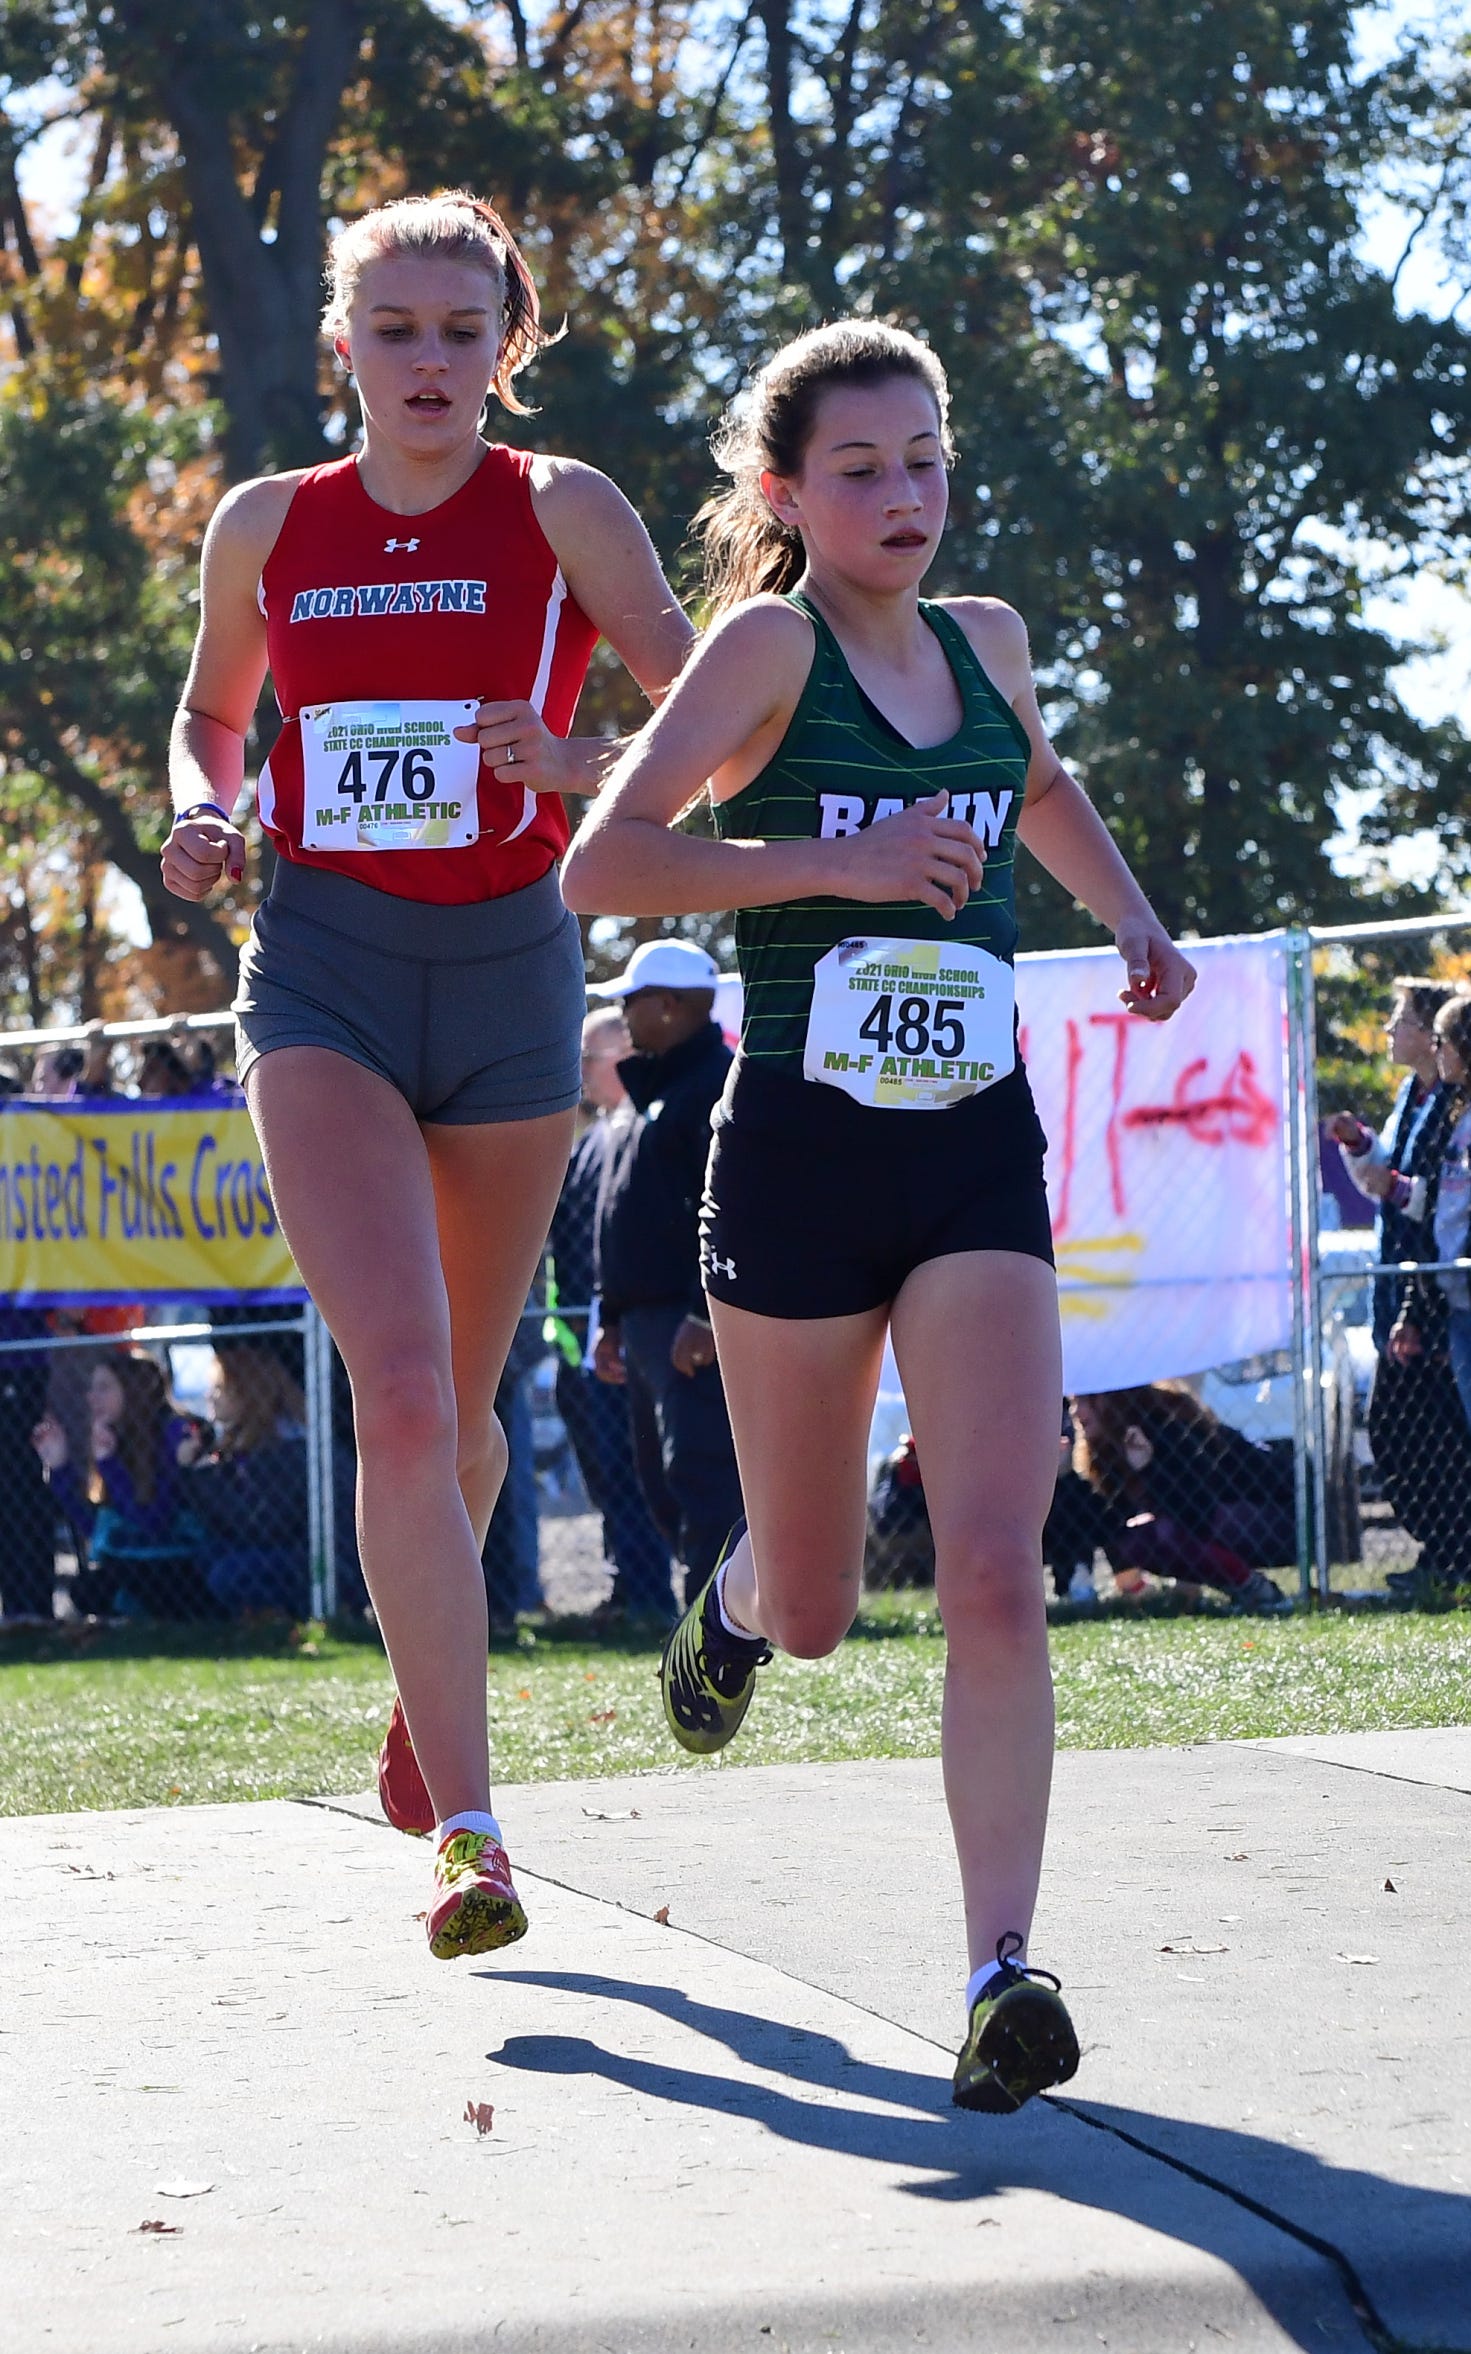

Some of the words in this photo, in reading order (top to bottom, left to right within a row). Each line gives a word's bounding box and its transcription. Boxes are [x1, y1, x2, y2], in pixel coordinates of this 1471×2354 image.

[290, 579, 487, 624] NORWAYNE
[404, 721, 445, 734] SCHOOL
[323, 739, 348, 752] STATE
[349, 738, 364, 749] CC
[365, 734, 451, 749] CHAMPIONSHIPS
[337, 748, 436, 803] 476
[316, 806, 352, 826] M-F
[358, 801, 462, 823] ATHLETIC
[884, 964, 910, 978] OHIO
[938, 968, 980, 984] SCHOOL
[848, 977, 879, 993] STATE
[881, 980, 896, 994] CC
[898, 981, 985, 999] CHAMPIONSHIPS
[859, 994, 965, 1058] 485
[823, 1051, 874, 1073] M-F
[880, 1056, 995, 1081] ATHLETIC
[879, 1076, 903, 1086] 00485
[91, 1129, 185, 1241] Falls
